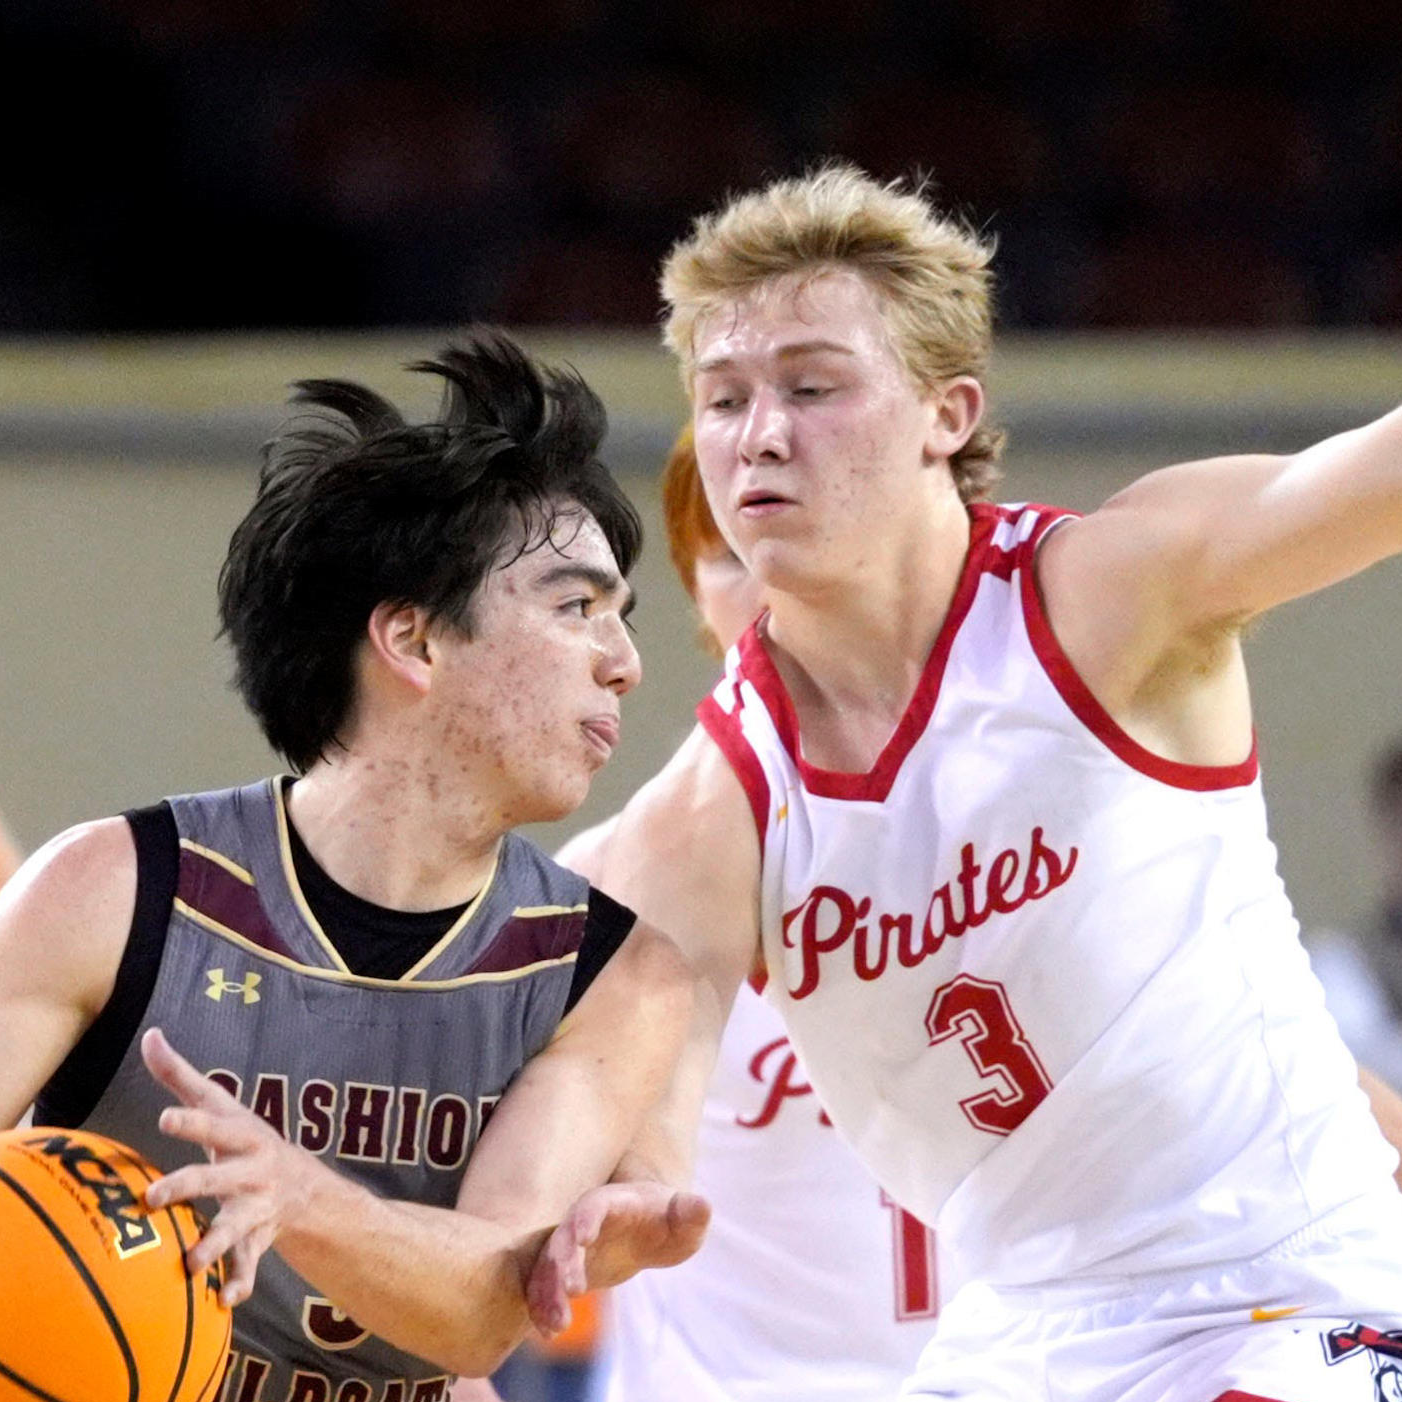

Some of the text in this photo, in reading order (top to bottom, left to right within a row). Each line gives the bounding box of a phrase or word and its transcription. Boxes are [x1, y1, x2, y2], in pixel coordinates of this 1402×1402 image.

[782, 826, 1079, 1000] Pirates
[204, 1068, 502, 1170] ASHIO
[925, 973, 1055, 1137] 3
